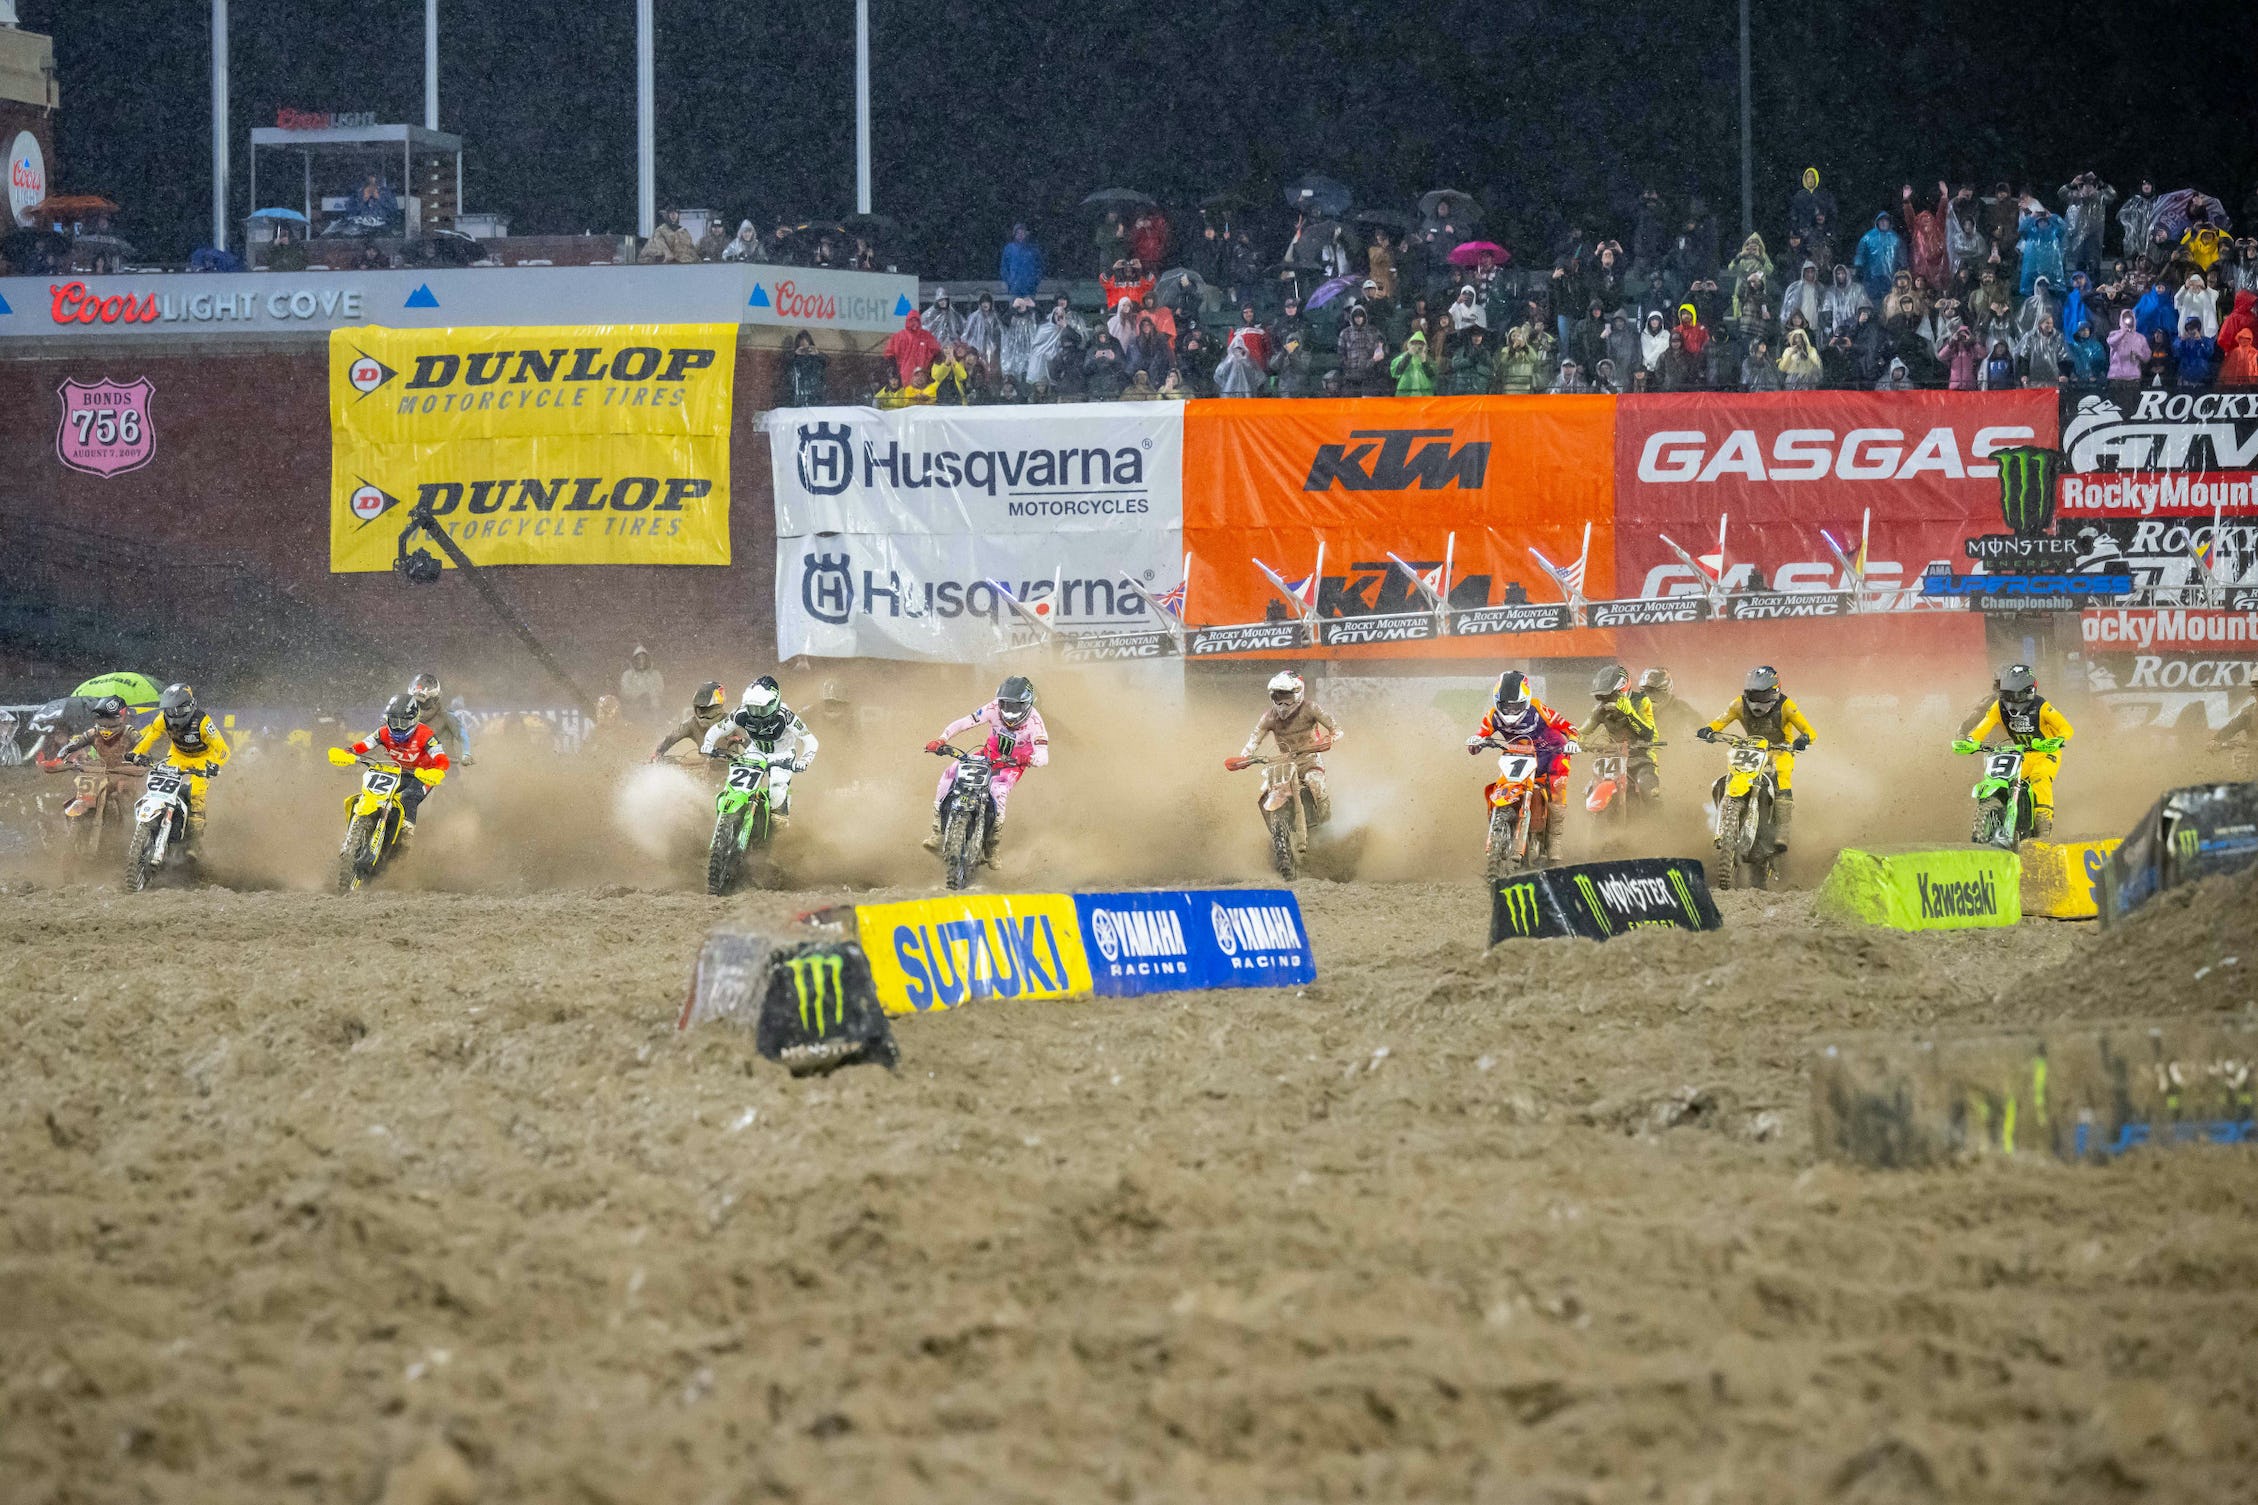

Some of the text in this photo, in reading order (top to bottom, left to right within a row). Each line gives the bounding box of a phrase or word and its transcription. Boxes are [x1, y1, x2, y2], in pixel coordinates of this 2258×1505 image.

[13, 160, 41, 191] Coors
[50, 281, 363, 324] Coors LIGHT COVE
[775, 280, 889, 322] Coors LIGHT
[405, 346, 716, 390] DUNLOP
[83, 393, 132, 405] BONDS
[397, 387, 686, 415] MOTORCYCLE TIRES
[72, 409, 142, 446] 756
[73, 450, 107, 458] AUGUST
[1303, 428, 1492, 491] KTM
[1637, 426, 2035, 483] GASGAS
[863, 440, 1143, 496] Husqvarna
[410, 477, 712, 516] DUNLOP
[1008, 499, 1149, 517] MOTORCYCLES
[606, 517, 683, 537] TIRES
[1968, 537, 2079, 558] MONSTER
[1929, 565, 1951, 576] AMA
[1986, 560, 2064, 568] ENERGY
[1315, 561, 1492, 617] KTM
[1923, 575, 2132, 595] SUPERCROSS
[1611, 601, 1697, 613] ROCKY MOUNTAIN
[1750, 594, 1838, 607] ROCKY MOUNTAIN
[1981, 596, 2074, 610] Championship
[1344, 618, 1428, 631] ROCKY MOUNTAIN
[1474, 608, 1559, 621] ROCKY MOUNTAIN
[1209, 627, 1293, 641] ROCKY MOUNTAIN
[1509, 758, 1528, 778] 1
[1595, 757, 1622, 777] 14
[1732, 750, 1760, 768] 94
[1990, 755, 2017, 778] 9
[147, 776, 180, 794] 28
[366, 774, 394, 792] 12
[729, 768, 762, 790] 21
[1597, 873, 1678, 914] MONSTER
[1917, 869, 1998, 919] Kawasaki
[1110, 909, 1188, 958] YAMAHA
[1227, 906, 1302, 951] YAMAHA
[893, 913, 1069, 1010] SUZUKI
[1110, 961, 1188, 976] RACING
[1231, 955, 1302, 969] RACING
